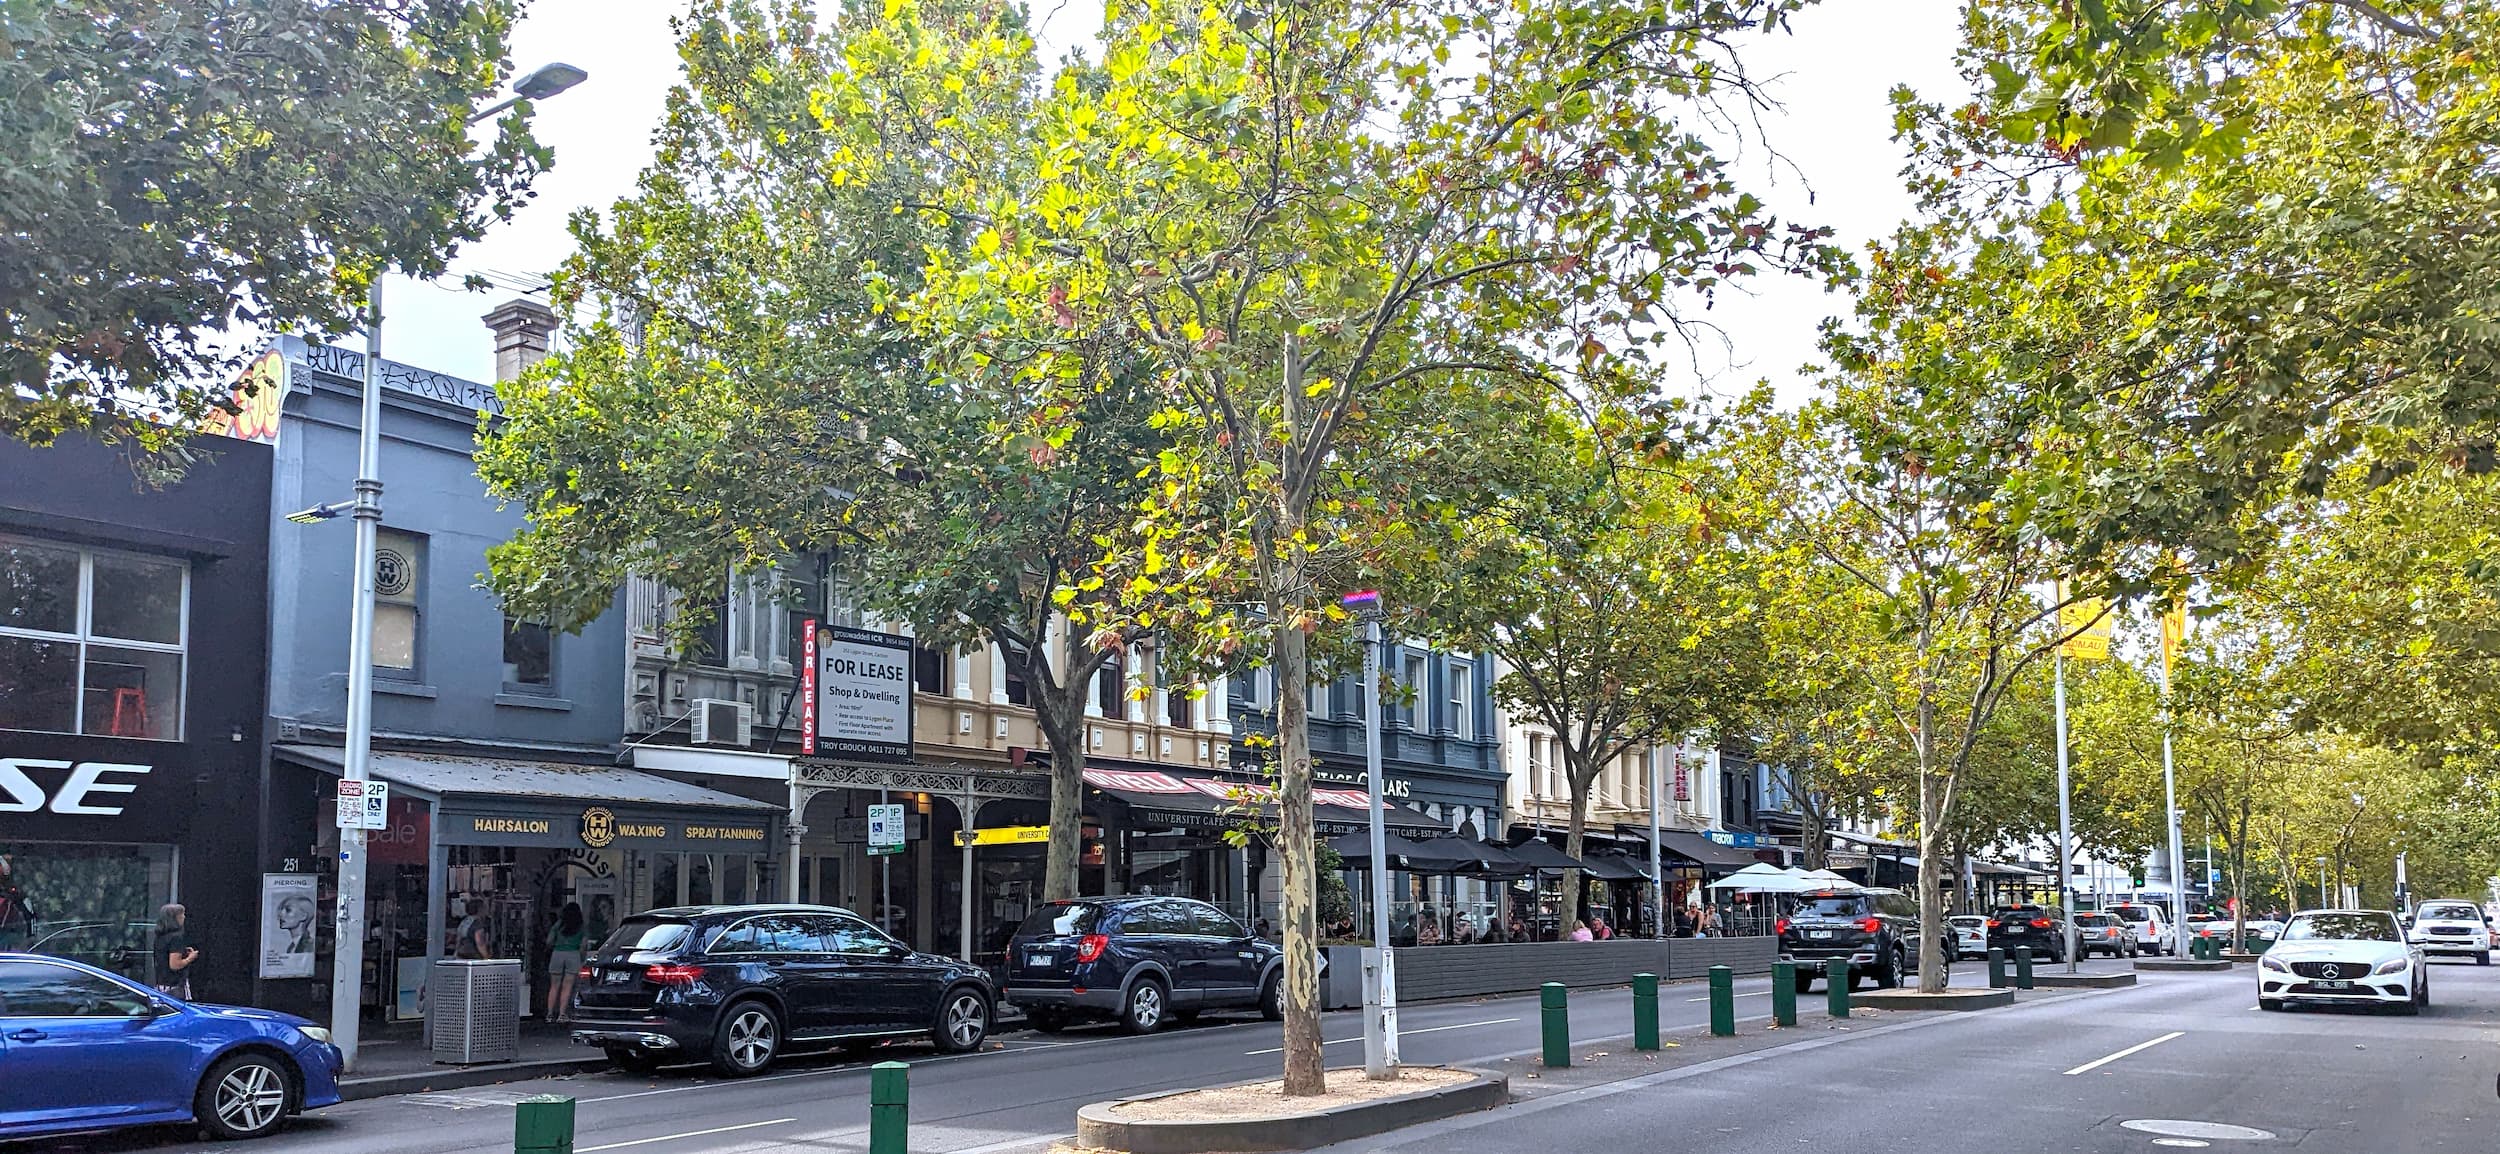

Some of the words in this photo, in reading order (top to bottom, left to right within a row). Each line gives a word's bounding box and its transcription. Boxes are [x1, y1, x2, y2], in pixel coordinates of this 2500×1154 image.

[805, 625, 813, 669] FOR
[825, 657, 855, 676] FOR
[860, 661, 903, 682] LEASE
[829, 685, 852, 700] Shop
[853, 688, 861, 698] &
[862, 689, 900, 705] Dwelling
[804, 676, 813, 750] LEASE
[820, 741, 838, 750] TROY
[839, 742, 866, 753] CROUCH
[868, 744, 883, 754] 0411
[884, 746, 895, 755] 727
[368, 784, 385, 796] 2P
[870, 808, 885, 818] 2P
[890, 808, 901, 817] 1P
[1148, 812, 1201, 825] UNIVERSITY
[474, 819, 549, 833] HAIRSALON
[590, 816, 607, 827] H
[590, 827, 607, 838] W
[618, 824, 666, 838] WAXING
[686, 826, 717, 839] SPRAY
[719, 828, 764, 840] TANNING
[1017, 830, 1044, 840] UNIVERSITY
[283, 858, 299, 872] 251
